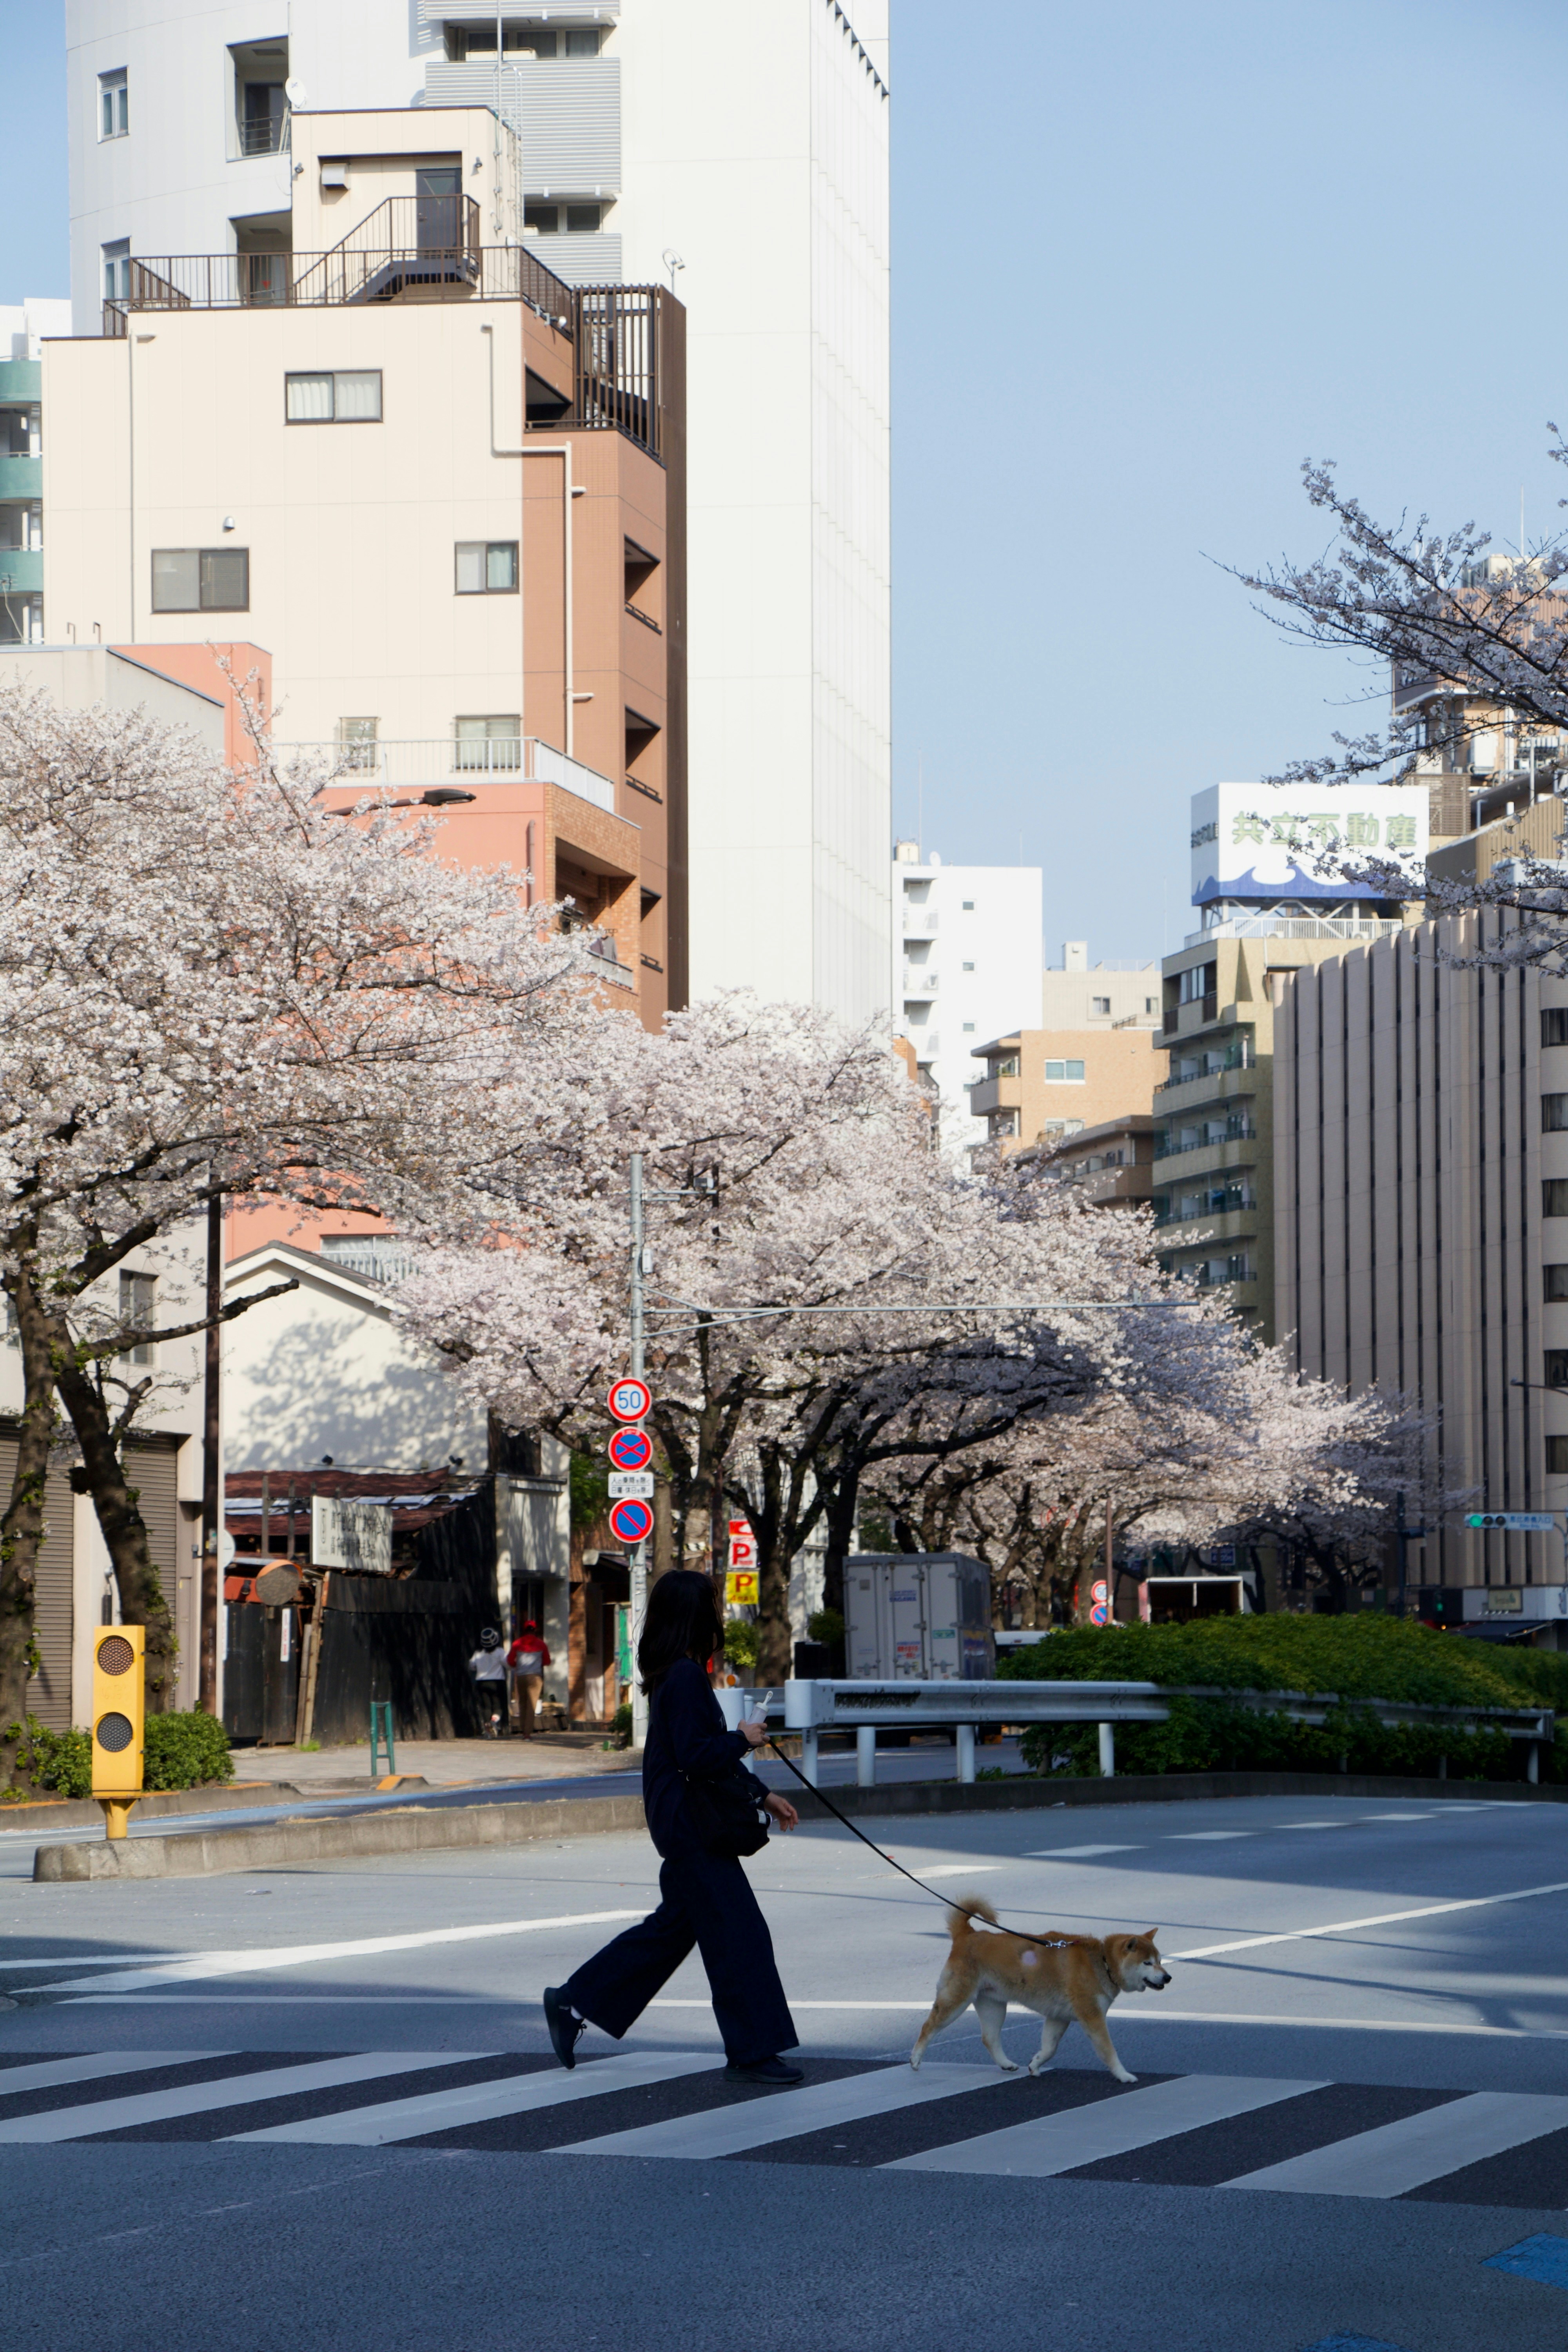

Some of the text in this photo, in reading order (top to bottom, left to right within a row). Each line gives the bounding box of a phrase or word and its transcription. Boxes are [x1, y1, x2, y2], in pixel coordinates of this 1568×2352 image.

[1232, 811, 1417, 847] 共立不動産
[618, 1391, 641, 1409] 50
[733, 1543, 750, 1565] P
[736, 1574, 753, 1592] P
